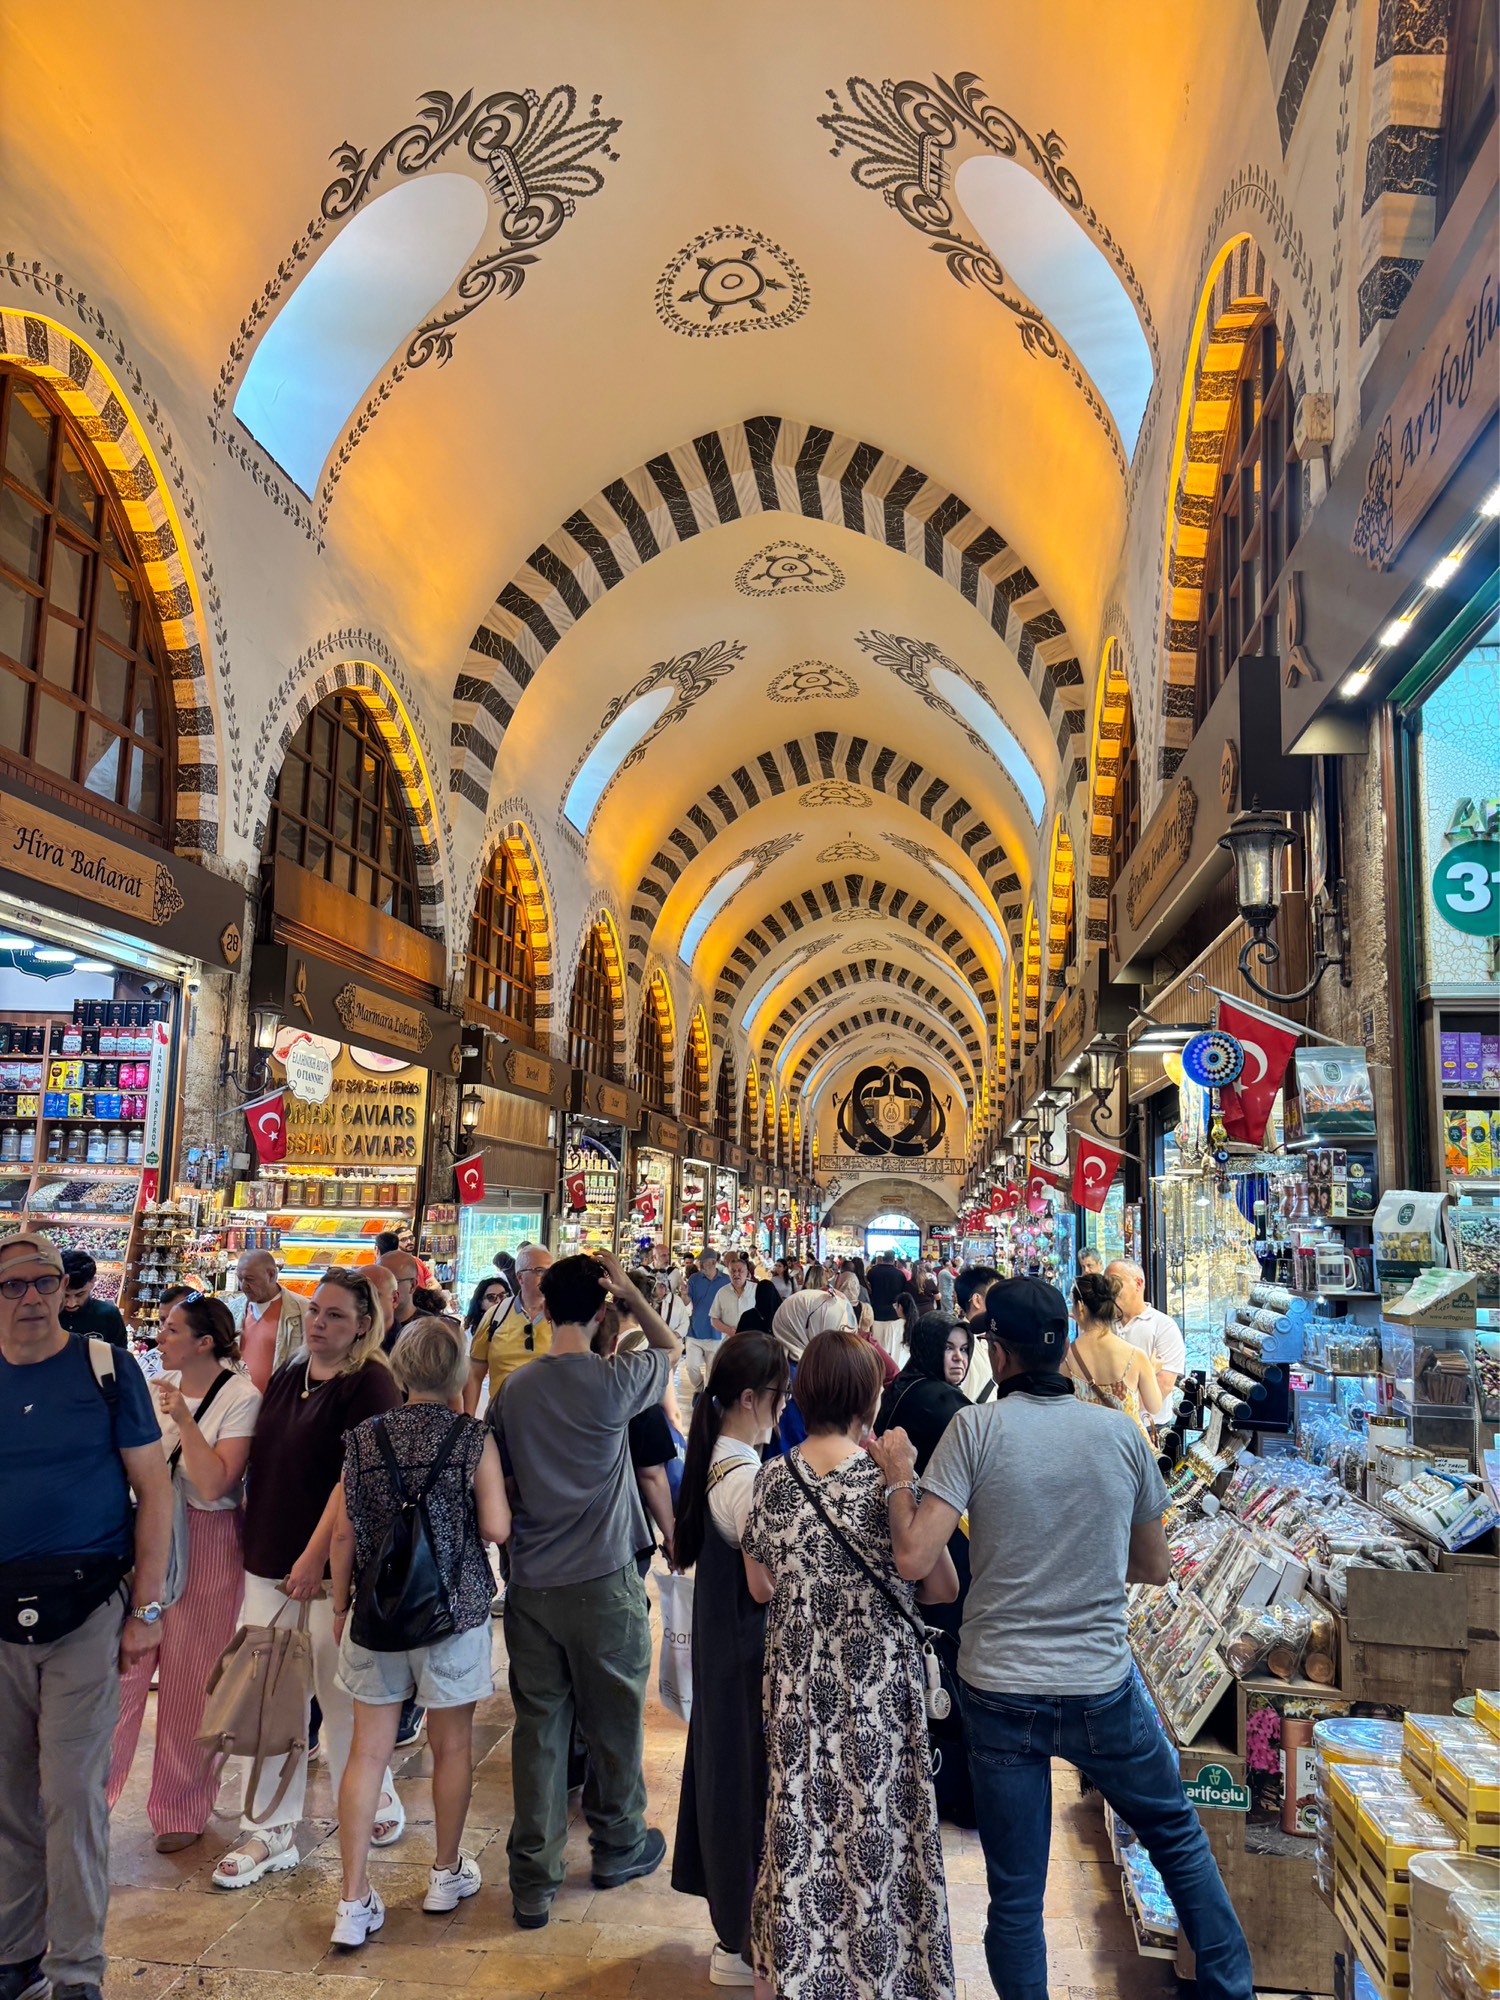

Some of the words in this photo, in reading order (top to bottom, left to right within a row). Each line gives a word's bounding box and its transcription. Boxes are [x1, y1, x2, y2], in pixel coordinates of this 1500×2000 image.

[13, 826, 64, 867] Hira
[70, 850, 143, 898] Baharat
[226, 933, 239, 952] 28
[355, 1002, 393, 1030] Marmara
[394, 1017, 418, 1039] Lokum
[151, 1100, 159, 1147] SAFFRON
[341, 1103, 416, 1127] CAVIARS
[342, 1134, 416, 1158] CAVIARS
[1186, 1785, 1244, 1804] arifoğlu
